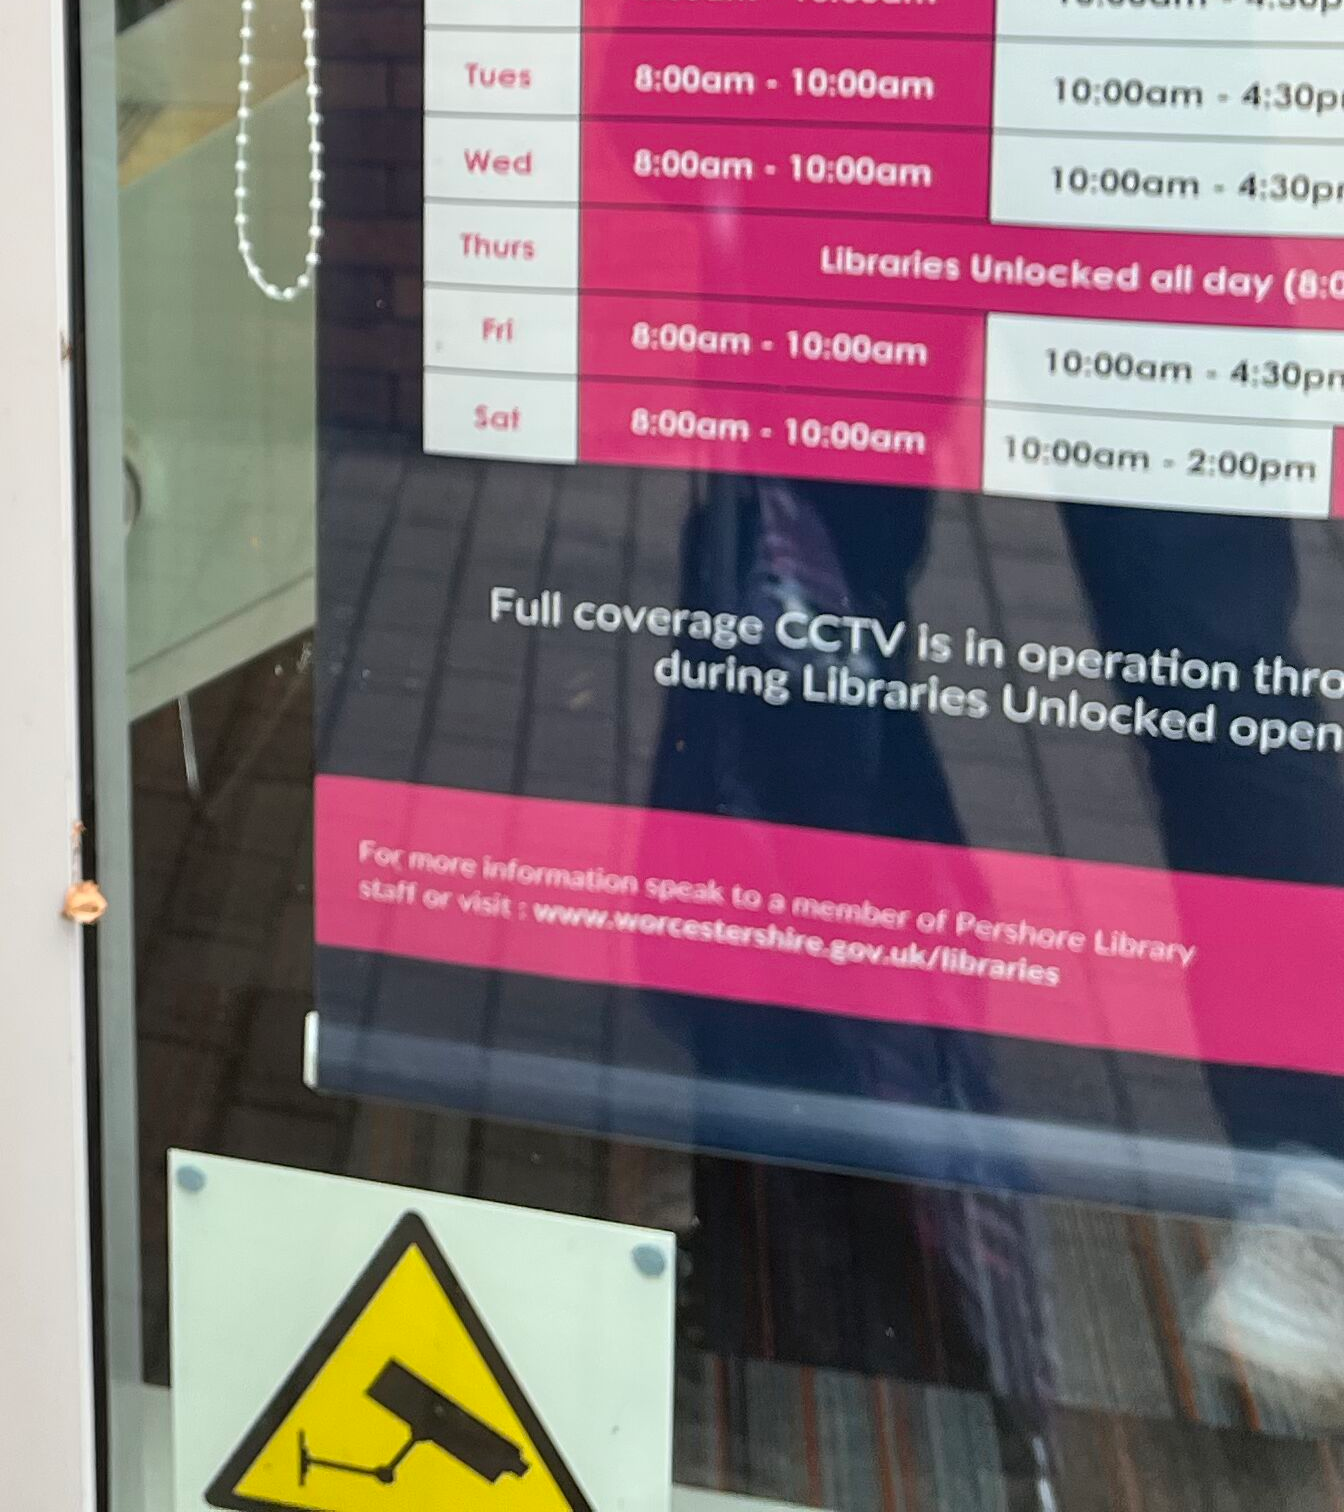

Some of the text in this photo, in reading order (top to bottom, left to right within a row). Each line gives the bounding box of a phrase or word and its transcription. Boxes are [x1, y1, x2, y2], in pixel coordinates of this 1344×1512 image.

[464, 62, 532, 89] Tues
[634, 64, 935, 100] 8:00am 10:00am
[1055, 77, 1203, 108] 10:00am
[464, 148, 533, 176] Wed
[633, 148, 933, 187] 8:00am 10:00am
[1052, 166, 1200, 198] 10:00am
[460, 232, 535, 261] Thurs
[820, 245, 961, 281] Libraries
[970, 253, 1141, 292] Unlocked
[1150, 264, 1195, 294] all
[1203, 266, 1273, 303] day
[482, 317, 514, 343] Fri
[631, 322, 929, 366] 8:00am 10:00am
[1046, 348, 1192, 383] 10:00am
[474, 404, 521, 431] Sat
[631, 408, 926, 454] 8:00am 10:00am
[1006, 436, 1316, 486] 10:00am 2:00pm
[491, 587, 562, 627] Full
[573, 602, 764, 649] coverage
[772, 610, 905, 656] CCTV
[918, 623, 952, 663] is
[966, 628, 1004, 668] in
[1018, 643, 1240, 692] operation
[654, 650, 1344, 754] during Libraries Unlocked open
[359, 840, 1199, 969] For more information speak to member of Pershore Library
[359, 877, 1062, 987] staff or visit www.worcestershire.gov.uk/libraries
